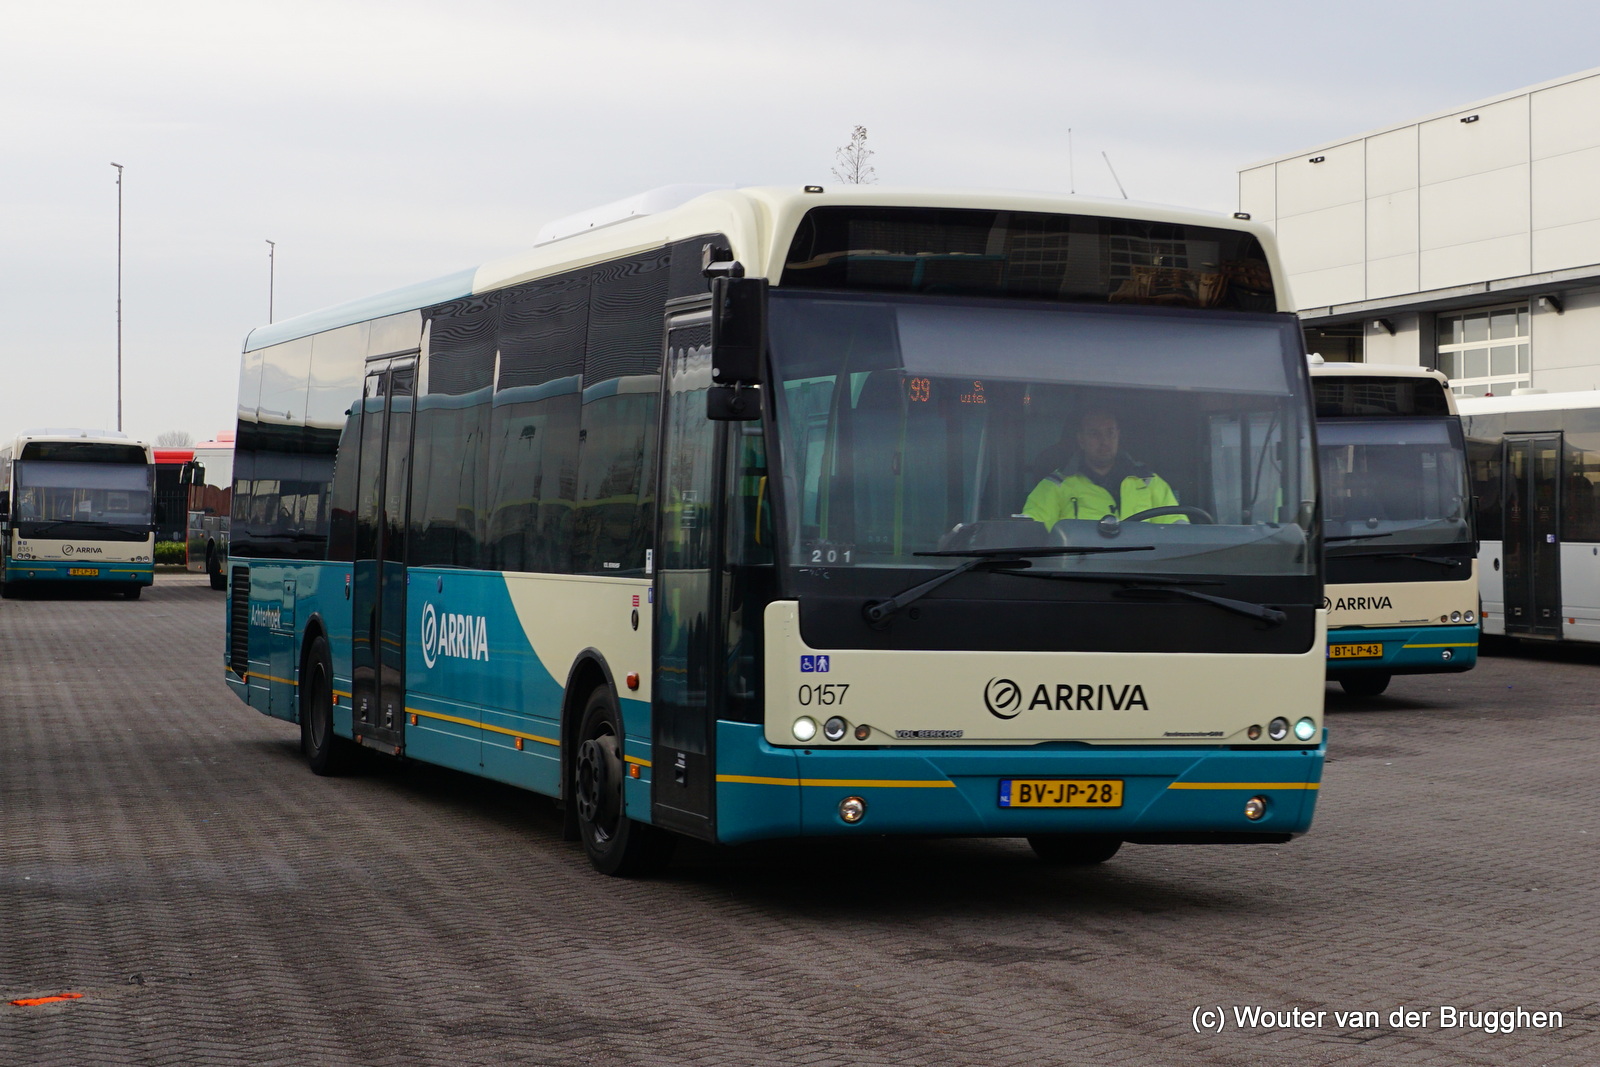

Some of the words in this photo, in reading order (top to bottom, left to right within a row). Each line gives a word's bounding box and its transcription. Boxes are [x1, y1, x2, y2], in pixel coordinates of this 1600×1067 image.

[902, 377, 931, 402] 99
[811, 549, 852, 563] 201
[1334, 596, 1393, 611] ARRIVA
[437, 612, 490, 662] ARRIVA
[1334, 644, 1379, 657] BT-LP-43
[798, 684, 850, 706] 0157
[1027, 683, 1149, 711] ARRIVA
[895, 730, 917, 738] VDL
[918, 730, 964, 738] BERKHOF
[1019, 783, 1113, 804] BV-JP-28
